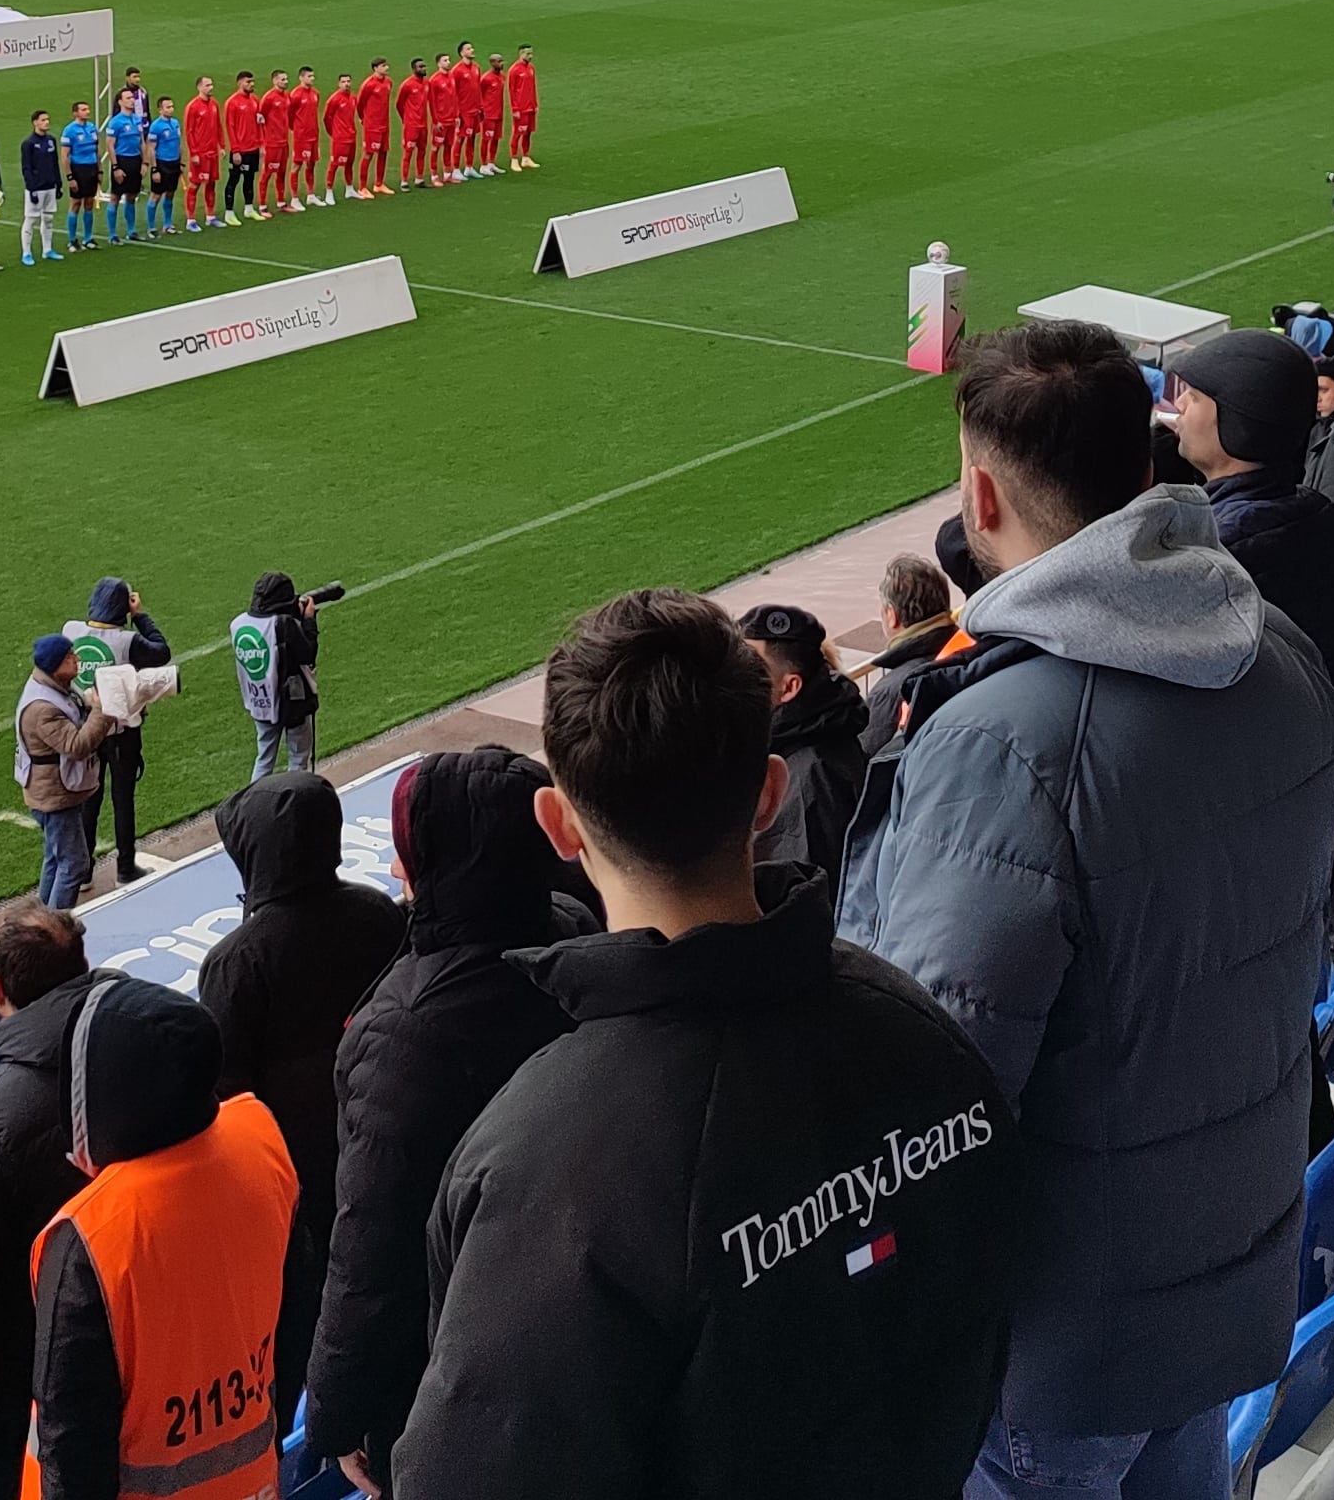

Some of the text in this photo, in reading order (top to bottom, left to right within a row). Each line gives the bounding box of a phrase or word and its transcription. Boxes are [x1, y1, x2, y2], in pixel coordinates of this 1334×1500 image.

[3, 34, 56, 56] SüperLig
[621, 204, 732, 245] SPORTOTO SüperLig
[159, 306, 321, 360] SPORTOTO SüperLig
